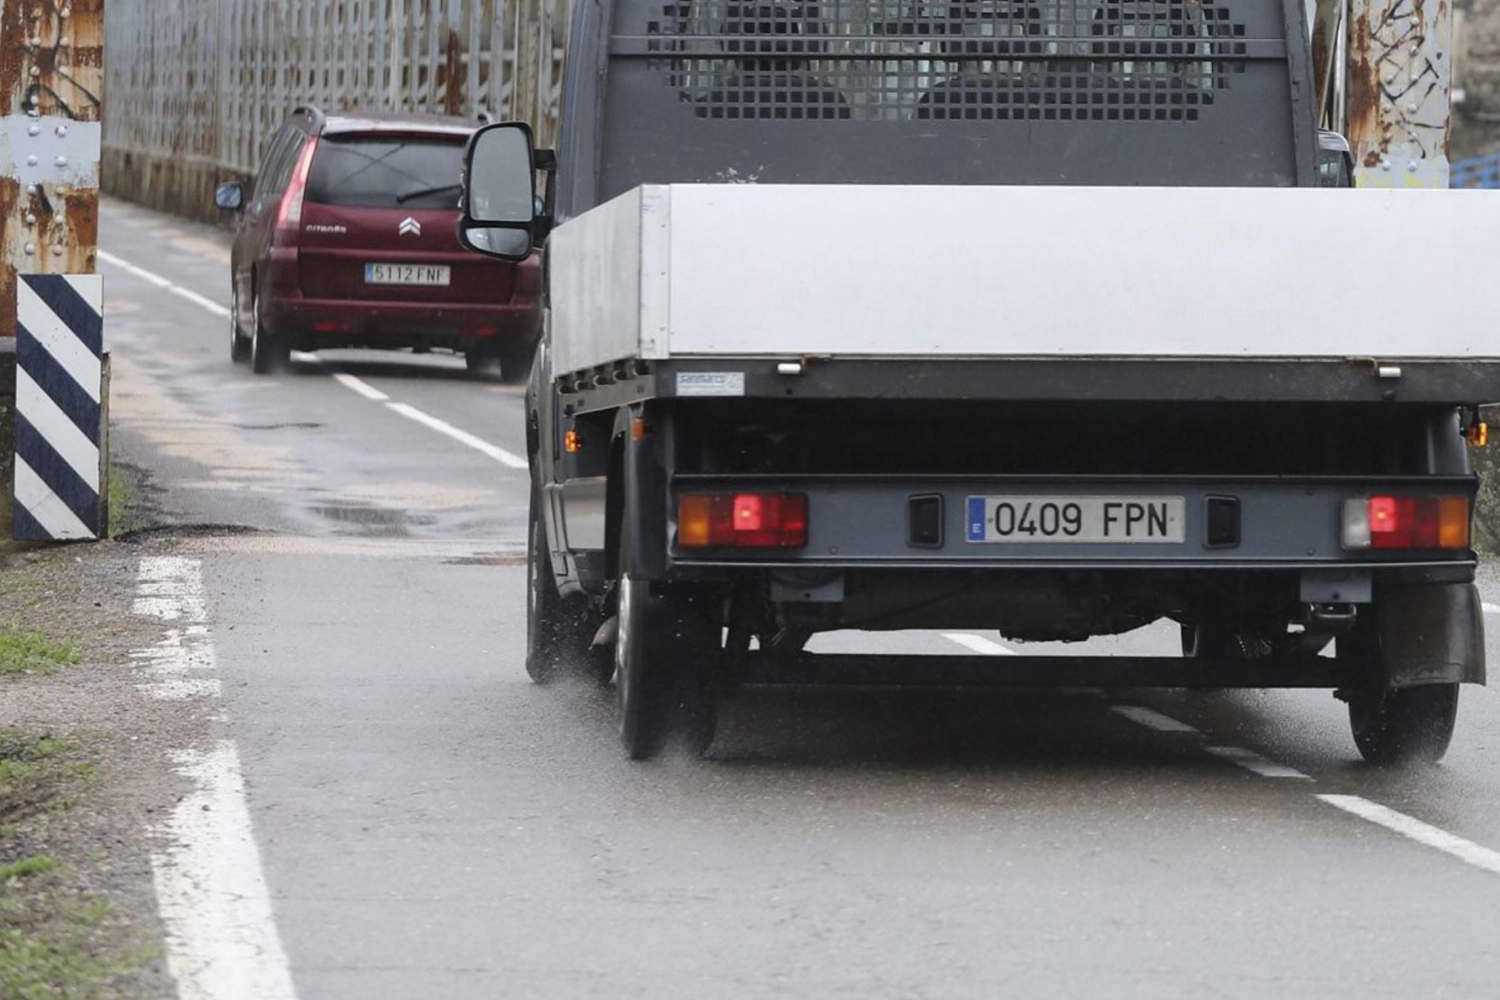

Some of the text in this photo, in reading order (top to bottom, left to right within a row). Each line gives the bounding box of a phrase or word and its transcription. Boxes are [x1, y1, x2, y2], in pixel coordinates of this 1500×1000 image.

[375, 265, 413, 281] 5112
[995, 503, 1082, 536] 0409
[1103, 503, 1167, 537] FPN
